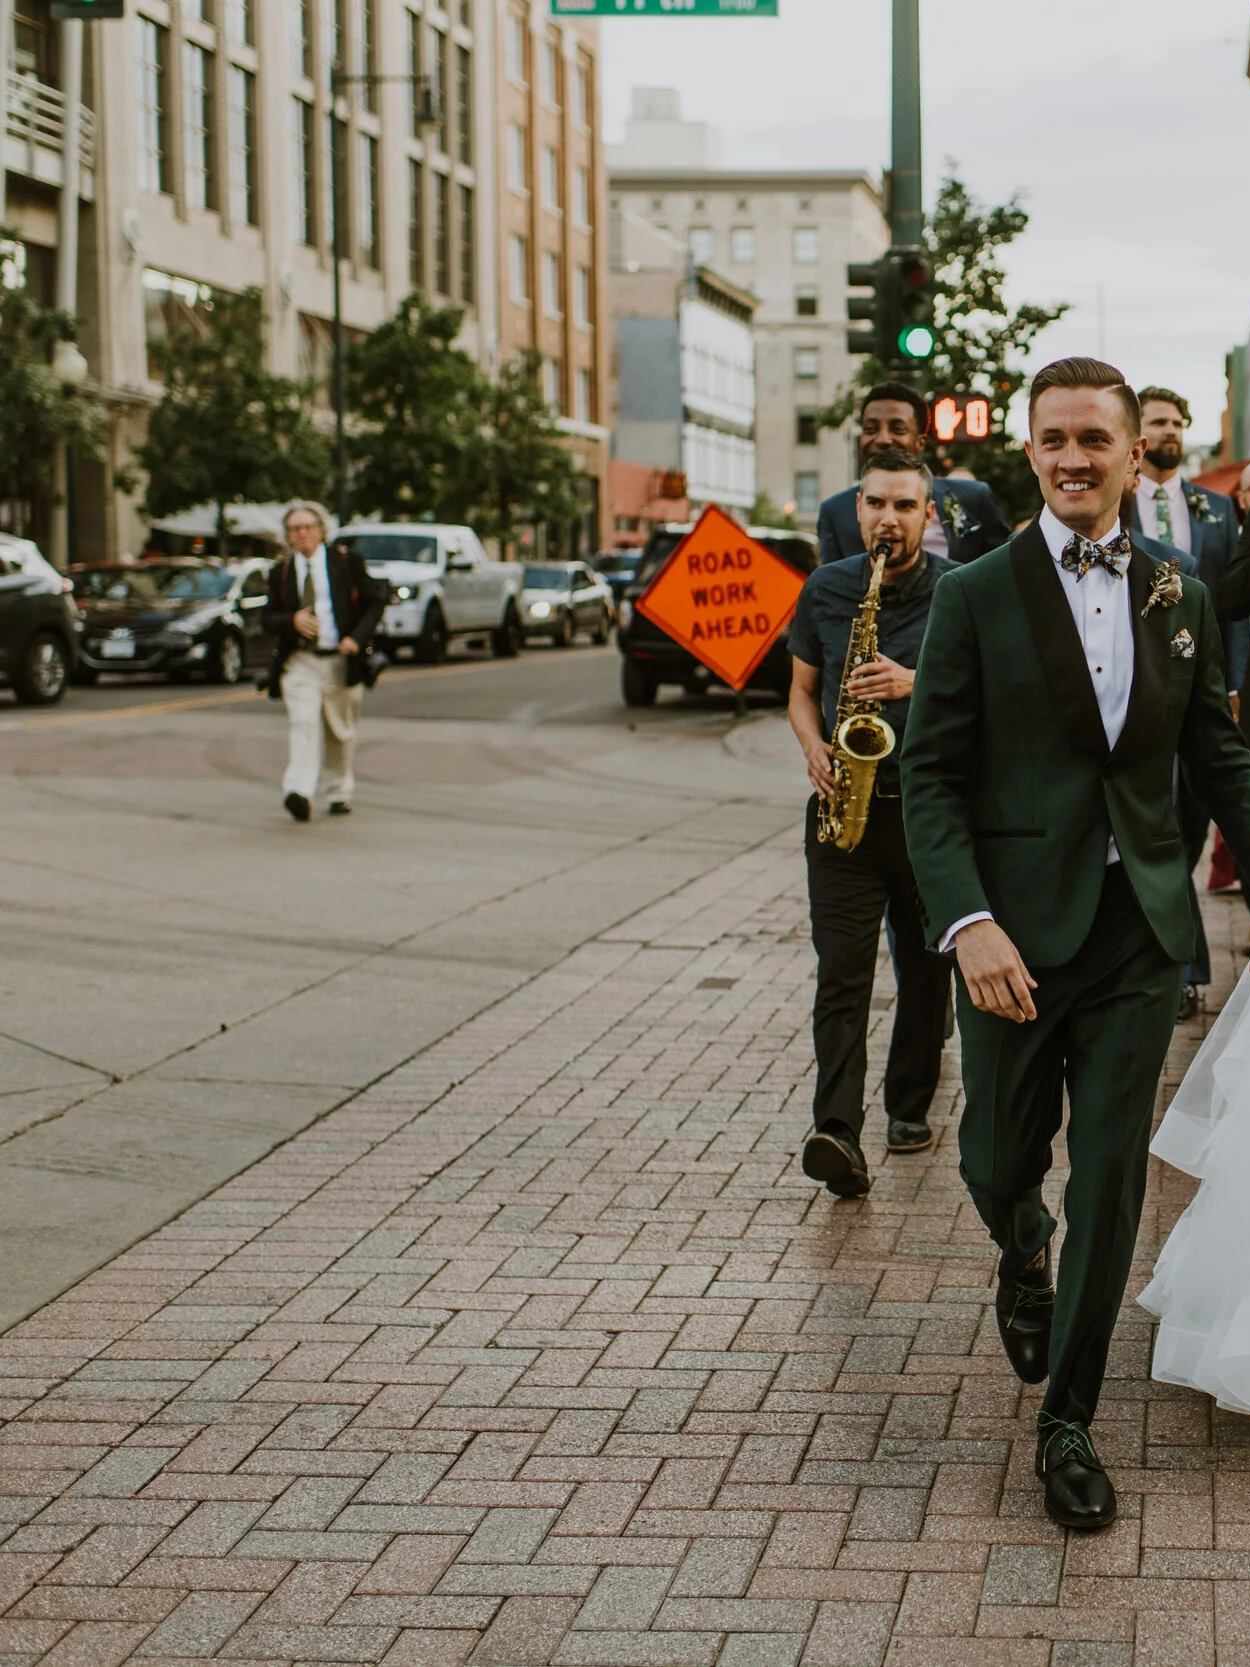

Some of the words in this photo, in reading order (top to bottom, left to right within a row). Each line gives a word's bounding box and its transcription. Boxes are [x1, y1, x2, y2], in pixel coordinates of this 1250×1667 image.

[687, 548, 752, 576] ROAD
[690, 580, 758, 608] WORK
[690, 613, 770, 642] AHEAD
